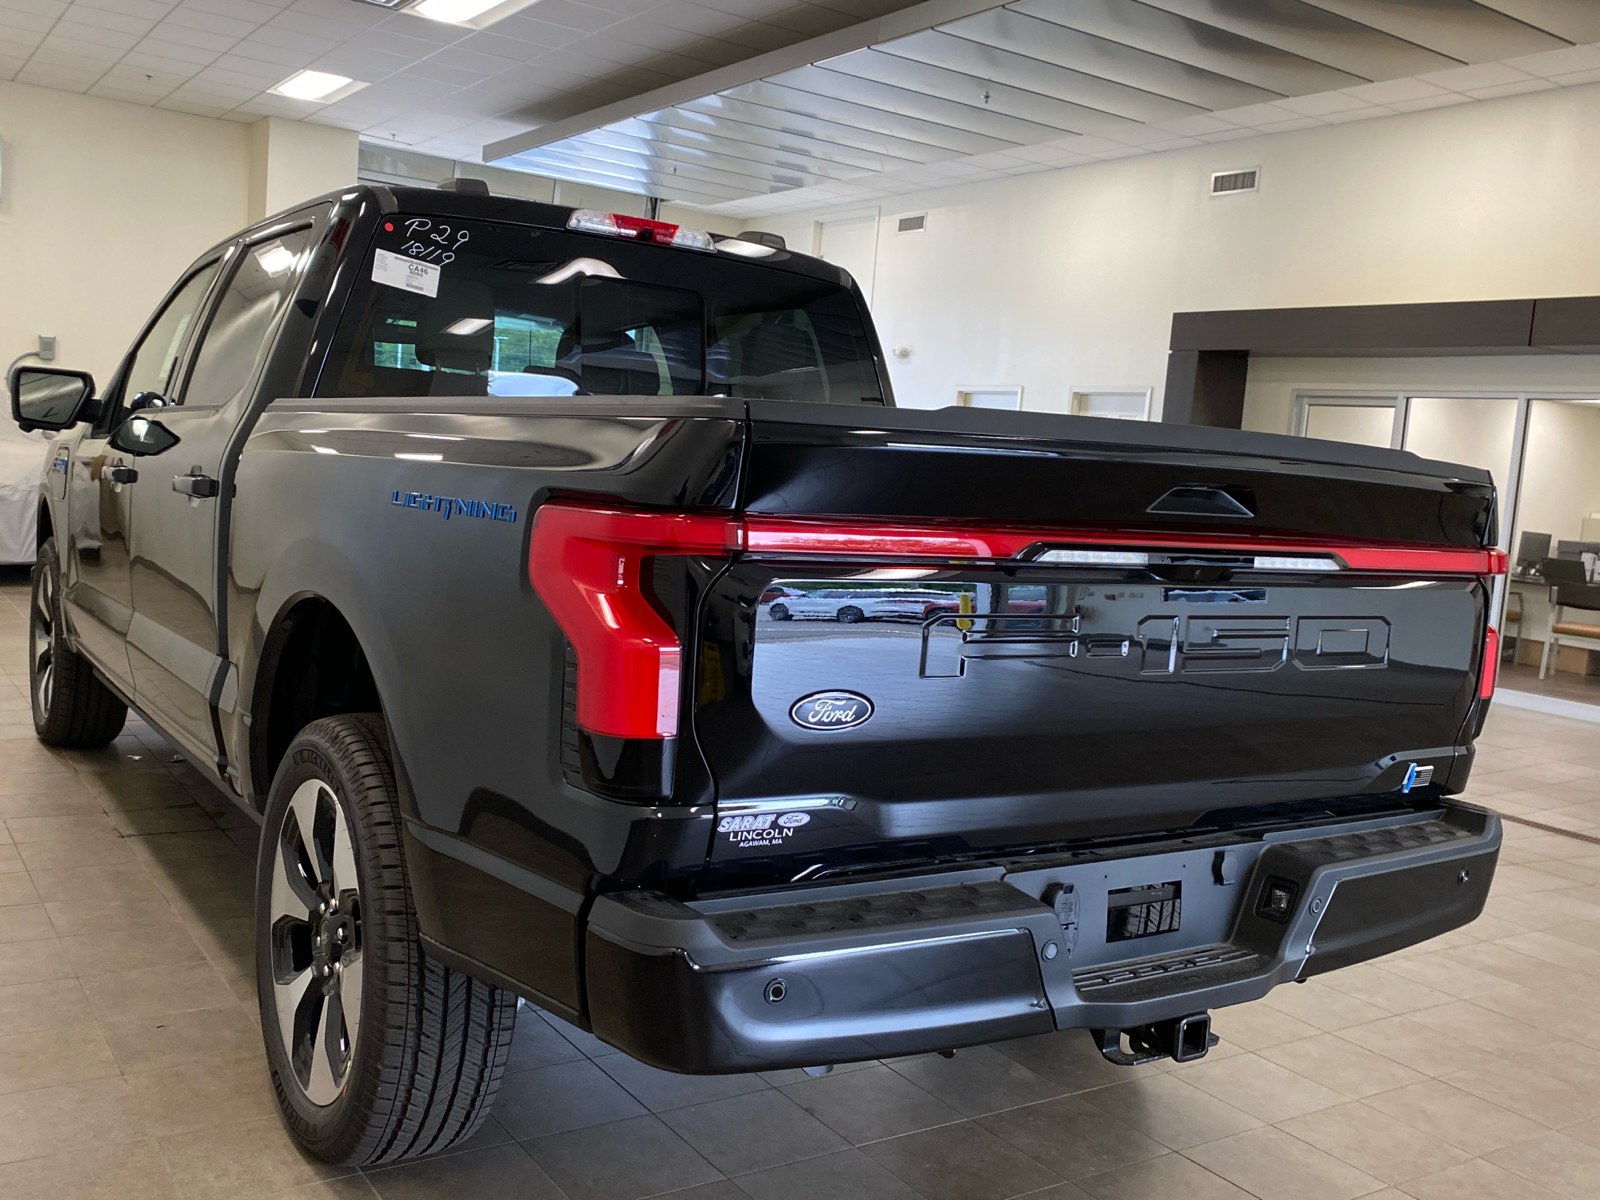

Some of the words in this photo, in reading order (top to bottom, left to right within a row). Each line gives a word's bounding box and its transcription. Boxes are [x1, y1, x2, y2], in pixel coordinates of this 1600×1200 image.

[408, 263, 429, 275] CA46
[391, 490, 516, 522] LIGHTNING
[919, 613, 1392, 679] F-150
[808, 699, 857, 722] Ford
[717, 814, 777, 832] SARAT
[729, 828, 794, 841] LINCOLN
